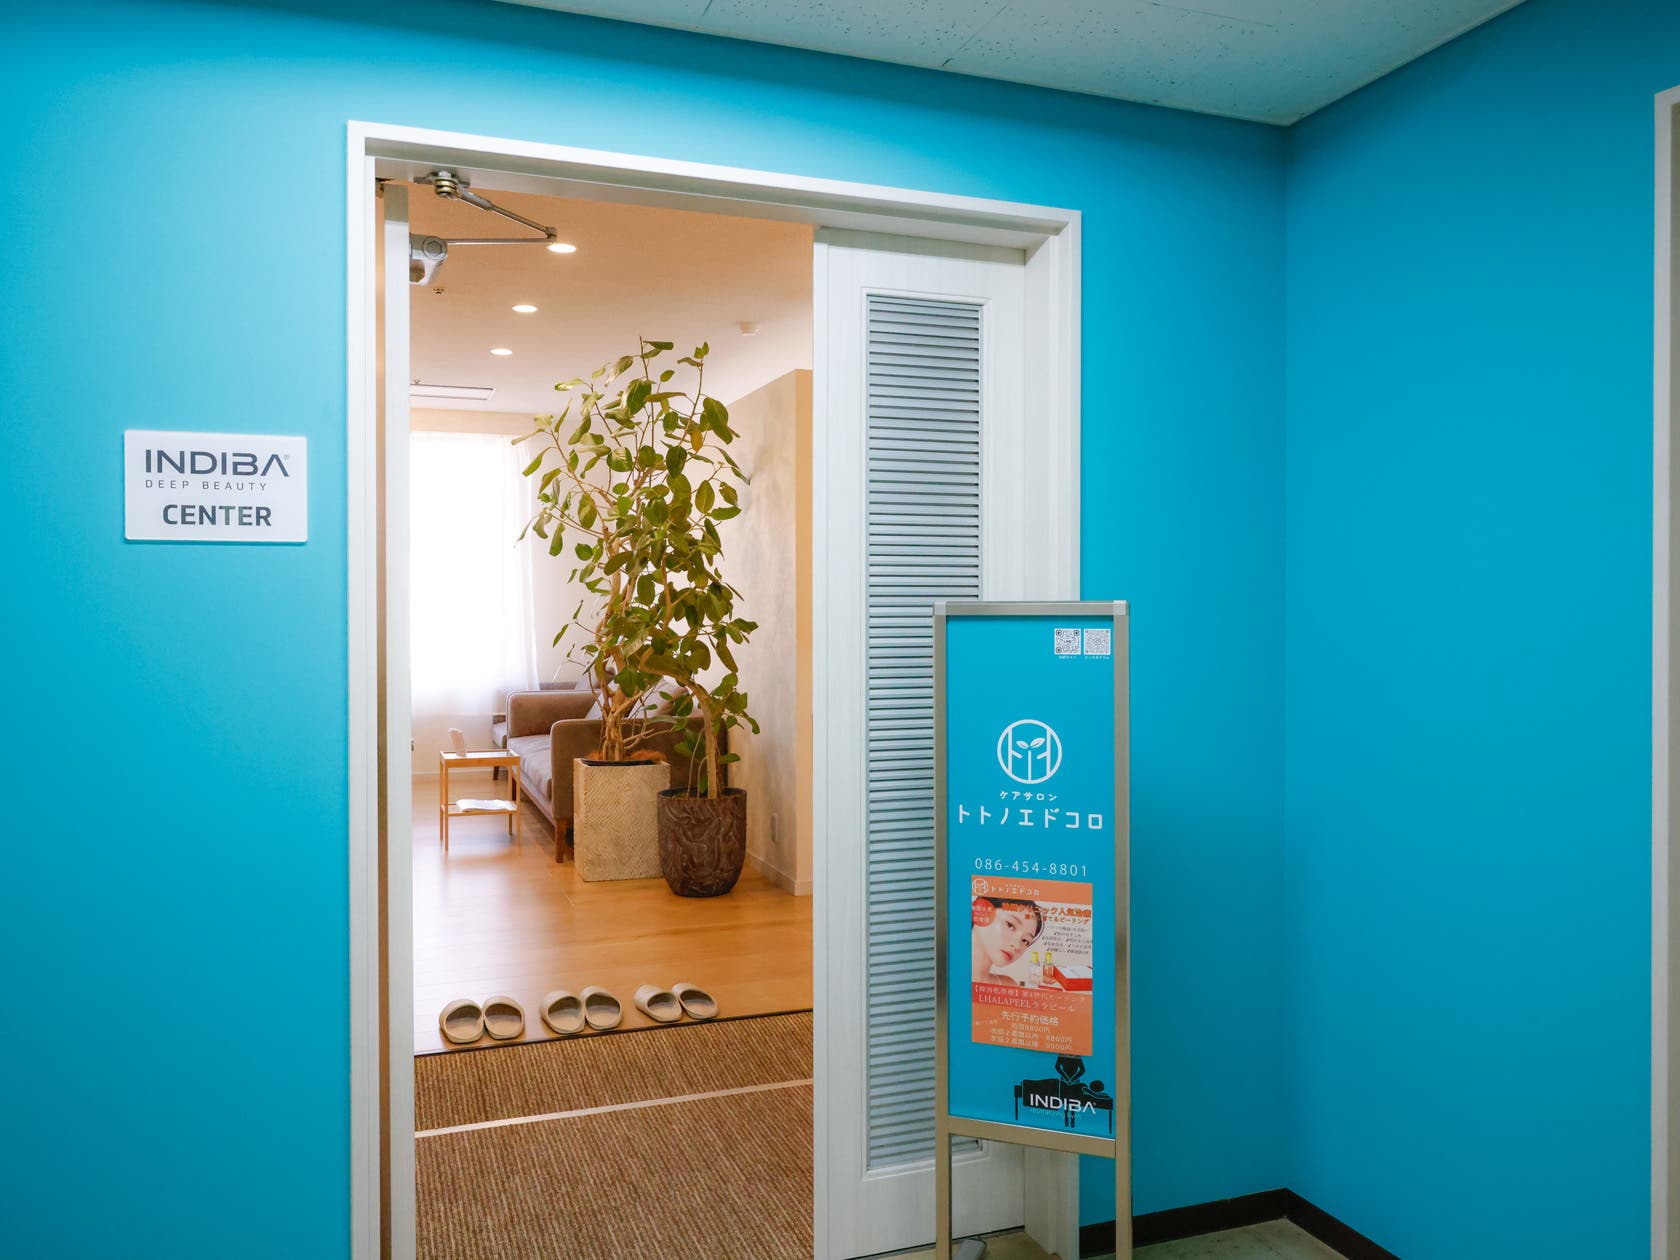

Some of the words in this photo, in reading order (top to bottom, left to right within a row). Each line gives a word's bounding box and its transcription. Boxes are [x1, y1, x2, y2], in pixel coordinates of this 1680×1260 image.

[145, 479, 190, 489] DEEP
[202, 481, 266, 491] BEAUTY
[163, 504, 272, 526] CENTER
[1000, 790, 1057, 801] ケアサロン
[959, 804, 1103, 830] トトノエドコロ
[974, 857, 1087, 877] 086-454-8801
